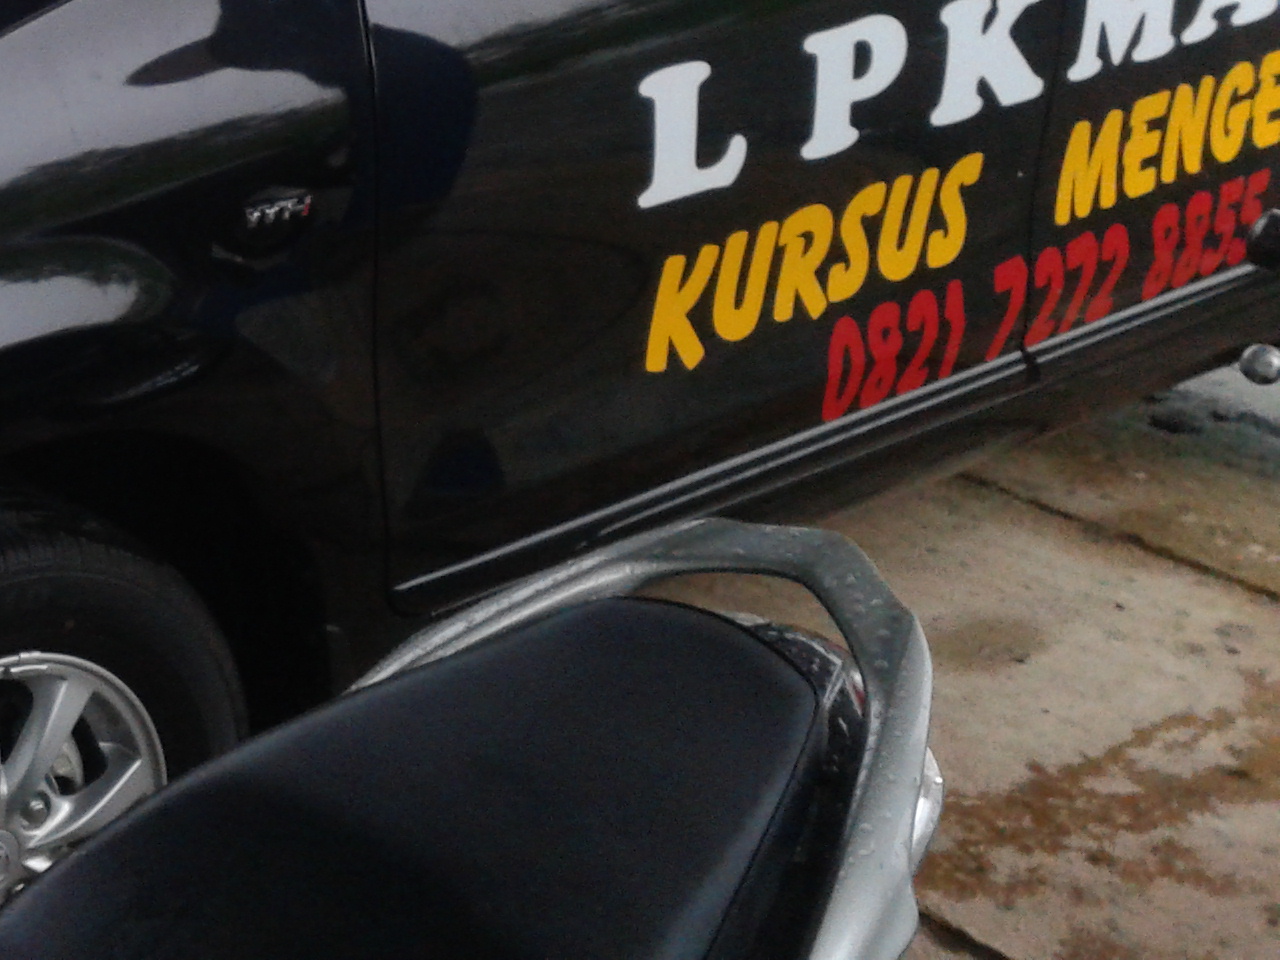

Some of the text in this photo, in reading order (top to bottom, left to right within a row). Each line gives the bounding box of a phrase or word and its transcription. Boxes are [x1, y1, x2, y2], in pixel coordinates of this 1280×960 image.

[645, 152, 985, 373] KURSUS
[822, 167, 1272, 422] 0821 7272 8855
